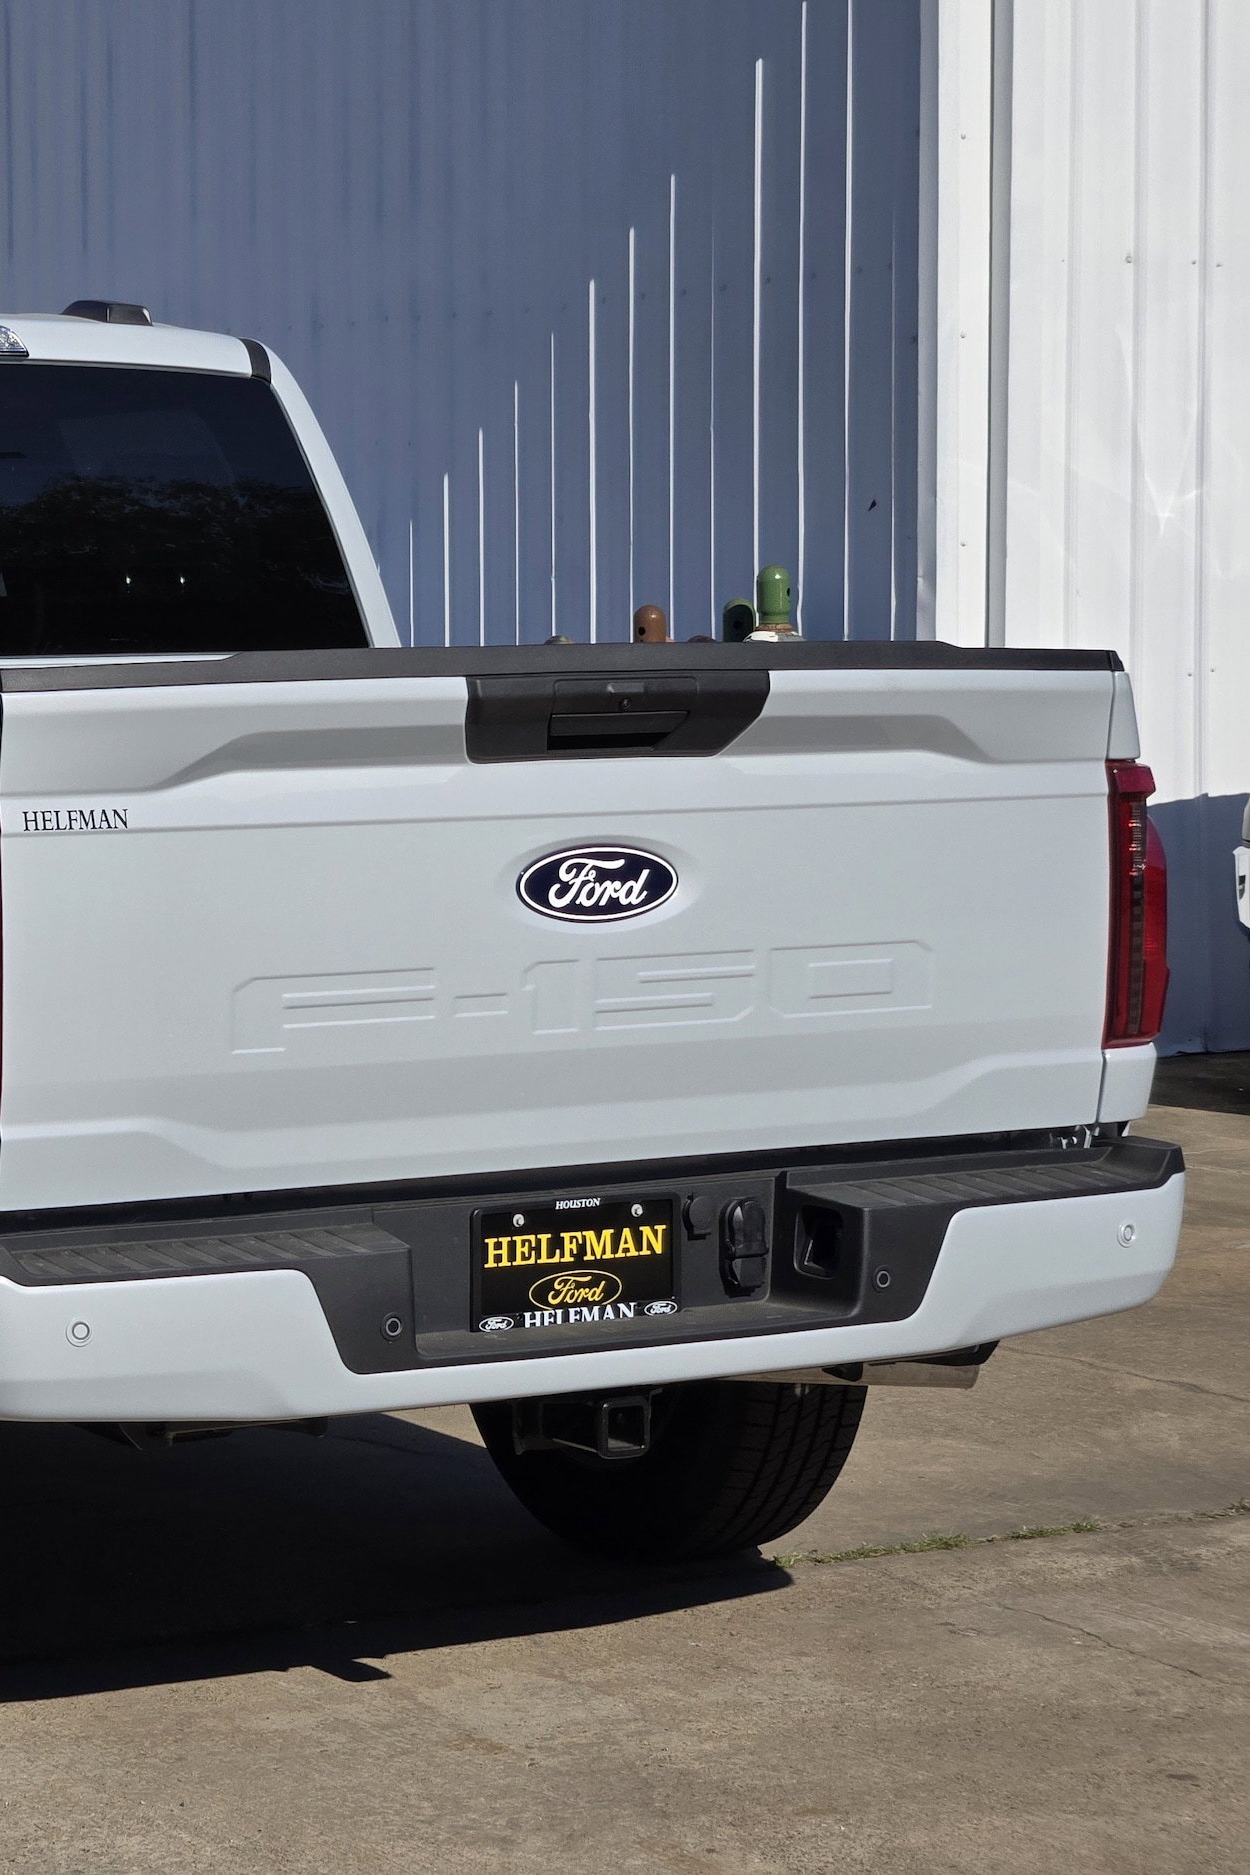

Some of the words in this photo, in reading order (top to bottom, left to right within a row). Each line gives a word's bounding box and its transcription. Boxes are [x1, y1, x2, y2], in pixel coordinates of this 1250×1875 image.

[22, 808, 128, 832] HELFMAN
[548, 857, 650, 908] Ford
[230, 939, 934, 1055] F-150
[555, 1198, 601, 1210] HOUSTON
[483, 1224, 667, 1269] HELFMAN
[547, 1275, 607, 1305] Ford
[485, 1319, 508, 1330] Ford
[650, 1303, 675, 1314] Ford
